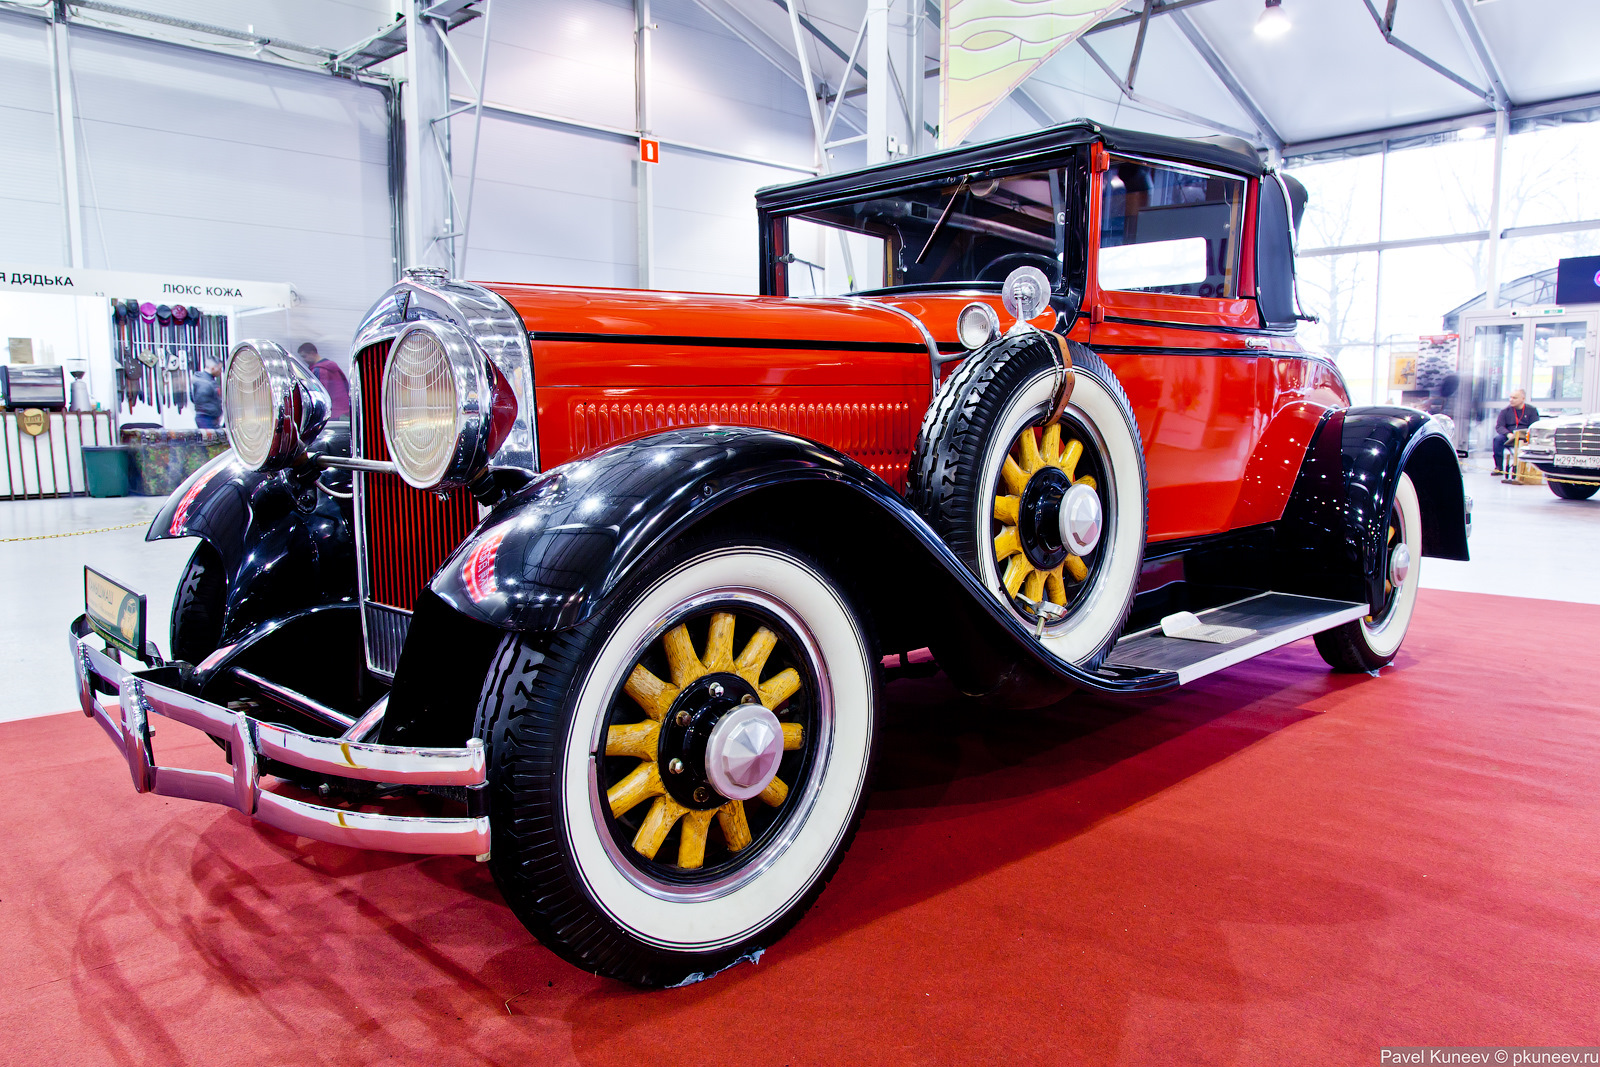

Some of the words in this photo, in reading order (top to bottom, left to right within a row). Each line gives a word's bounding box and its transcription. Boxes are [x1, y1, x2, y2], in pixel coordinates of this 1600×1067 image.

[11, 273, 74, 286] ДЯДЬКА
[163, 283, 202, 295] ЛЮКС
[206, 286, 243, 297] КОЖА
